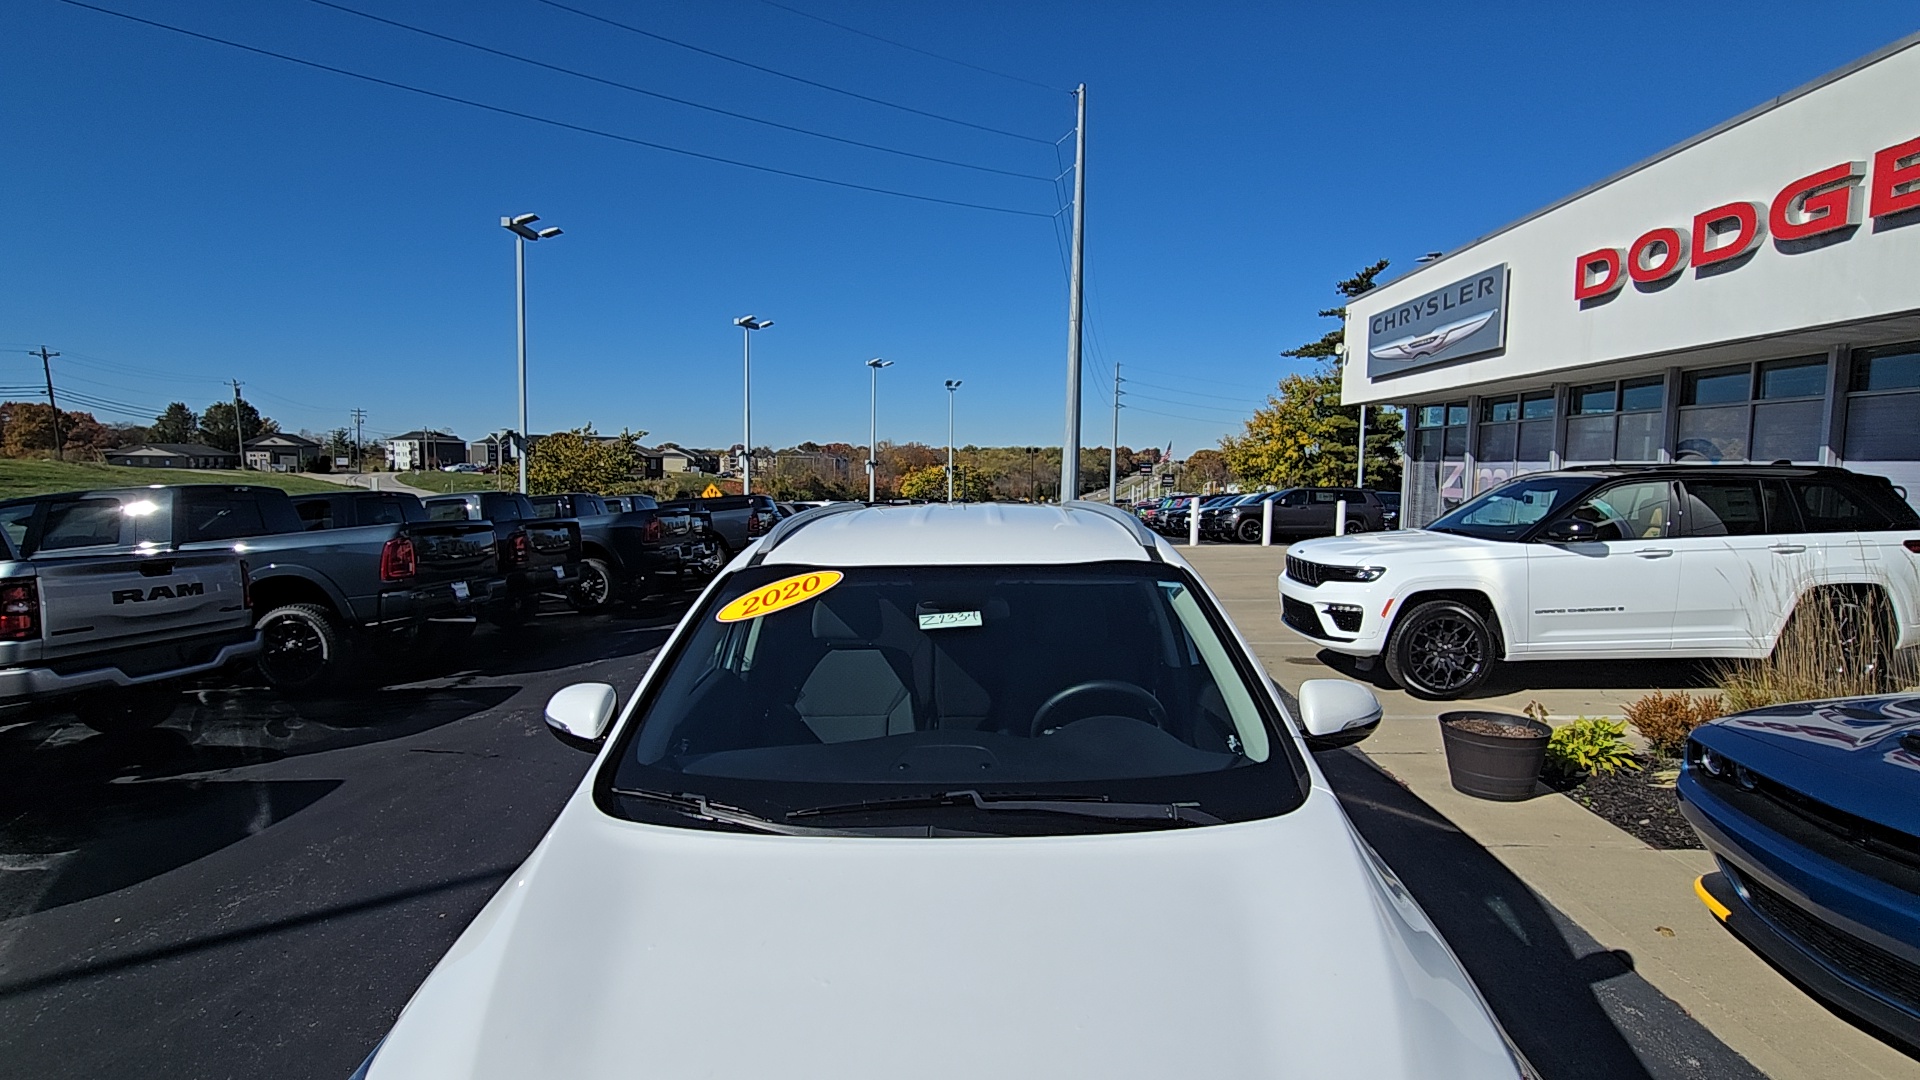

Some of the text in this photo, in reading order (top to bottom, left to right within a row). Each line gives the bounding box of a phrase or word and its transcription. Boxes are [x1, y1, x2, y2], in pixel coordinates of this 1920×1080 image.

[1574, 137, 1920, 300] DODGE
[1372, 276, 1494, 335] CHRYSLER
[112, 582, 204, 604] RAM
[741, 575, 821, 616] 2020
